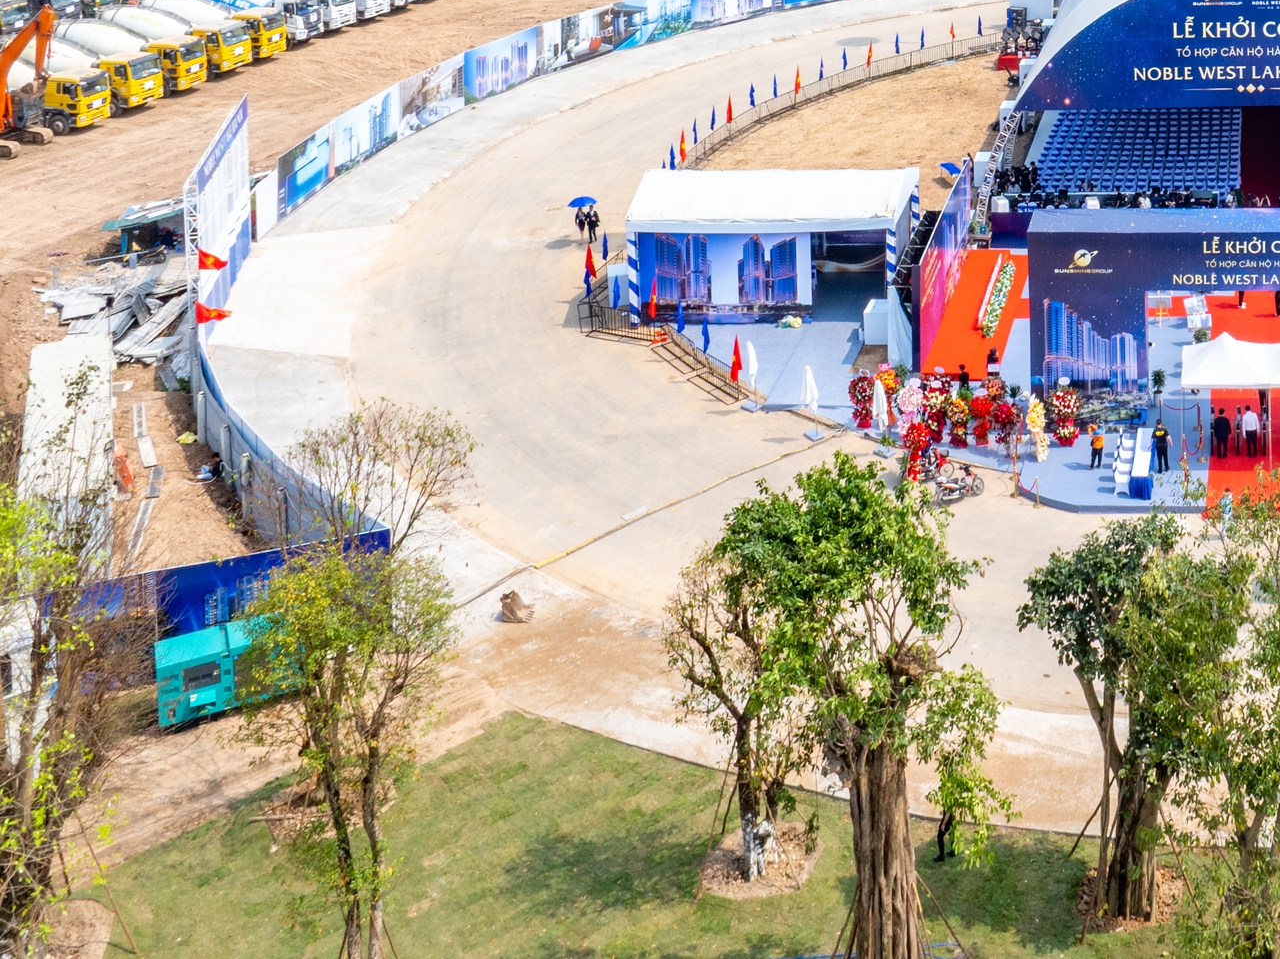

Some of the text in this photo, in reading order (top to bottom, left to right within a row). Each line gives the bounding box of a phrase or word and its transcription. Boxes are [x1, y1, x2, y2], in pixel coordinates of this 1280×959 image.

[1172, 15, 1196, 39] LỄ
[1202, 15, 1256, 39] KHỞI
[1176, 45, 1192, 57] TỔ
[1194, 46, 1218, 59] HỢP
[1220, 46, 1244, 57] CĂN
[1247, 45, 1264, 59] HỘ
[1133, 66, 1194, 81] NOBLE
[1198, 65, 1247, 80] WEST
[1202, 236, 1221, 254] LỄ
[1225, 236, 1267, 254] KHỞI
[1218, 260, 1237, 269] HỢP
[1238, 259, 1257, 268] CĂN
[1259, 258, 1272, 269] HỘ
[1172, 274, 1218, 285] NOBLE
[1222, 274, 1258, 285] WEST
